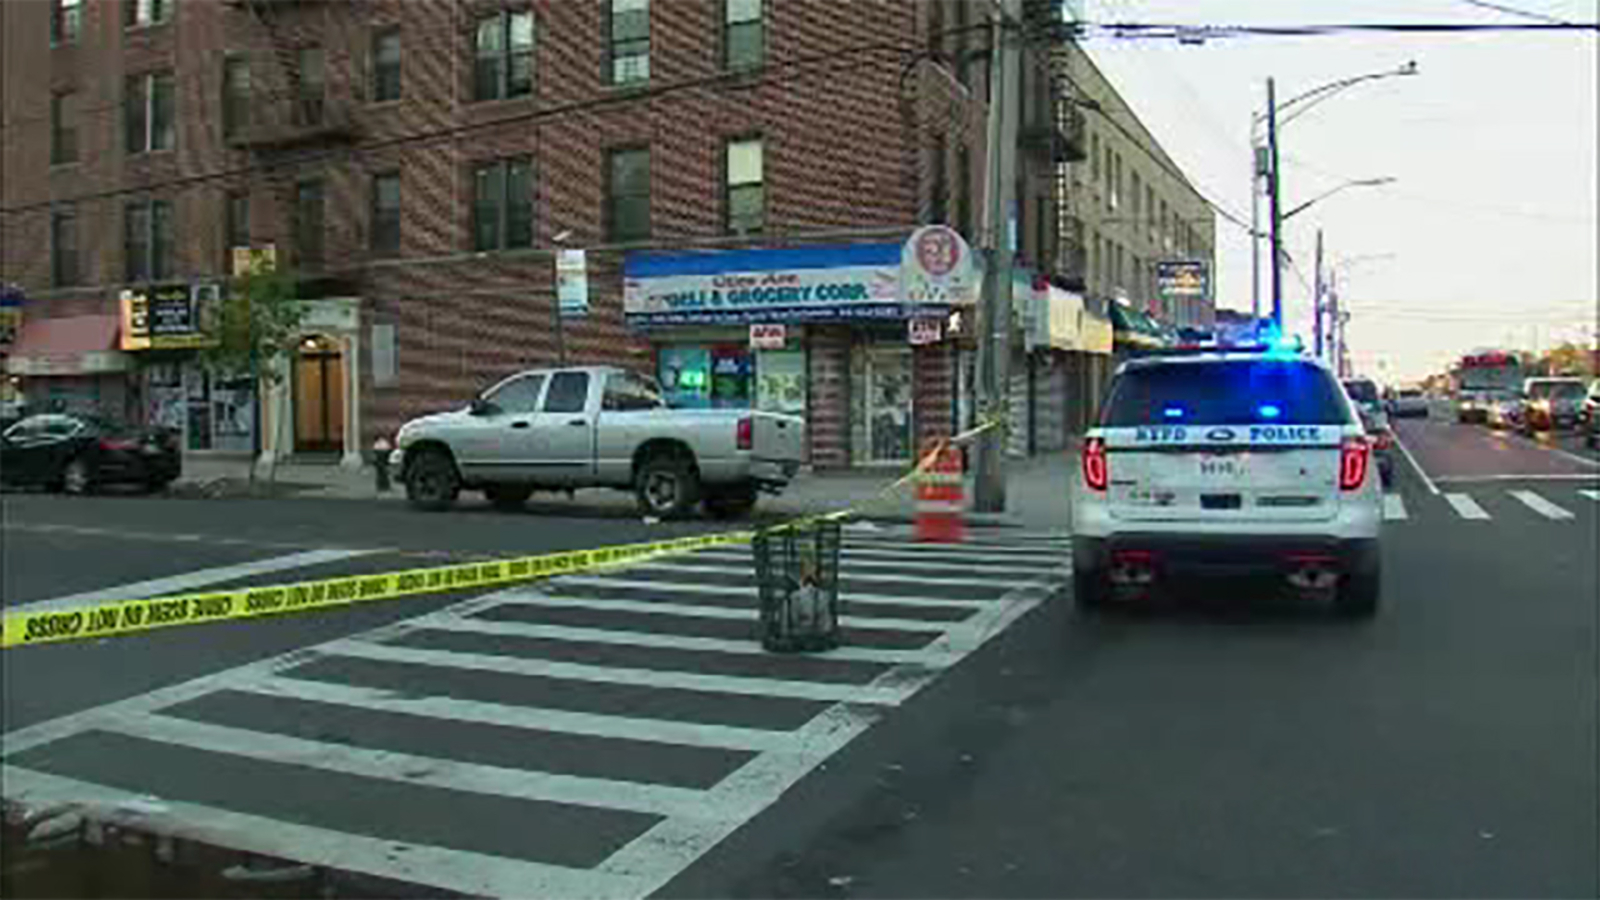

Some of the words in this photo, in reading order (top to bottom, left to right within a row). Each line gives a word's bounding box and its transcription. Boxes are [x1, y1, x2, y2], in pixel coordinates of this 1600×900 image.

[727, 284, 811, 306] GROCERY
[1136, 427, 1187, 441] NYPD
[1249, 426, 1320, 441] POLICE
[24, 612, 83, 640] CROSS
